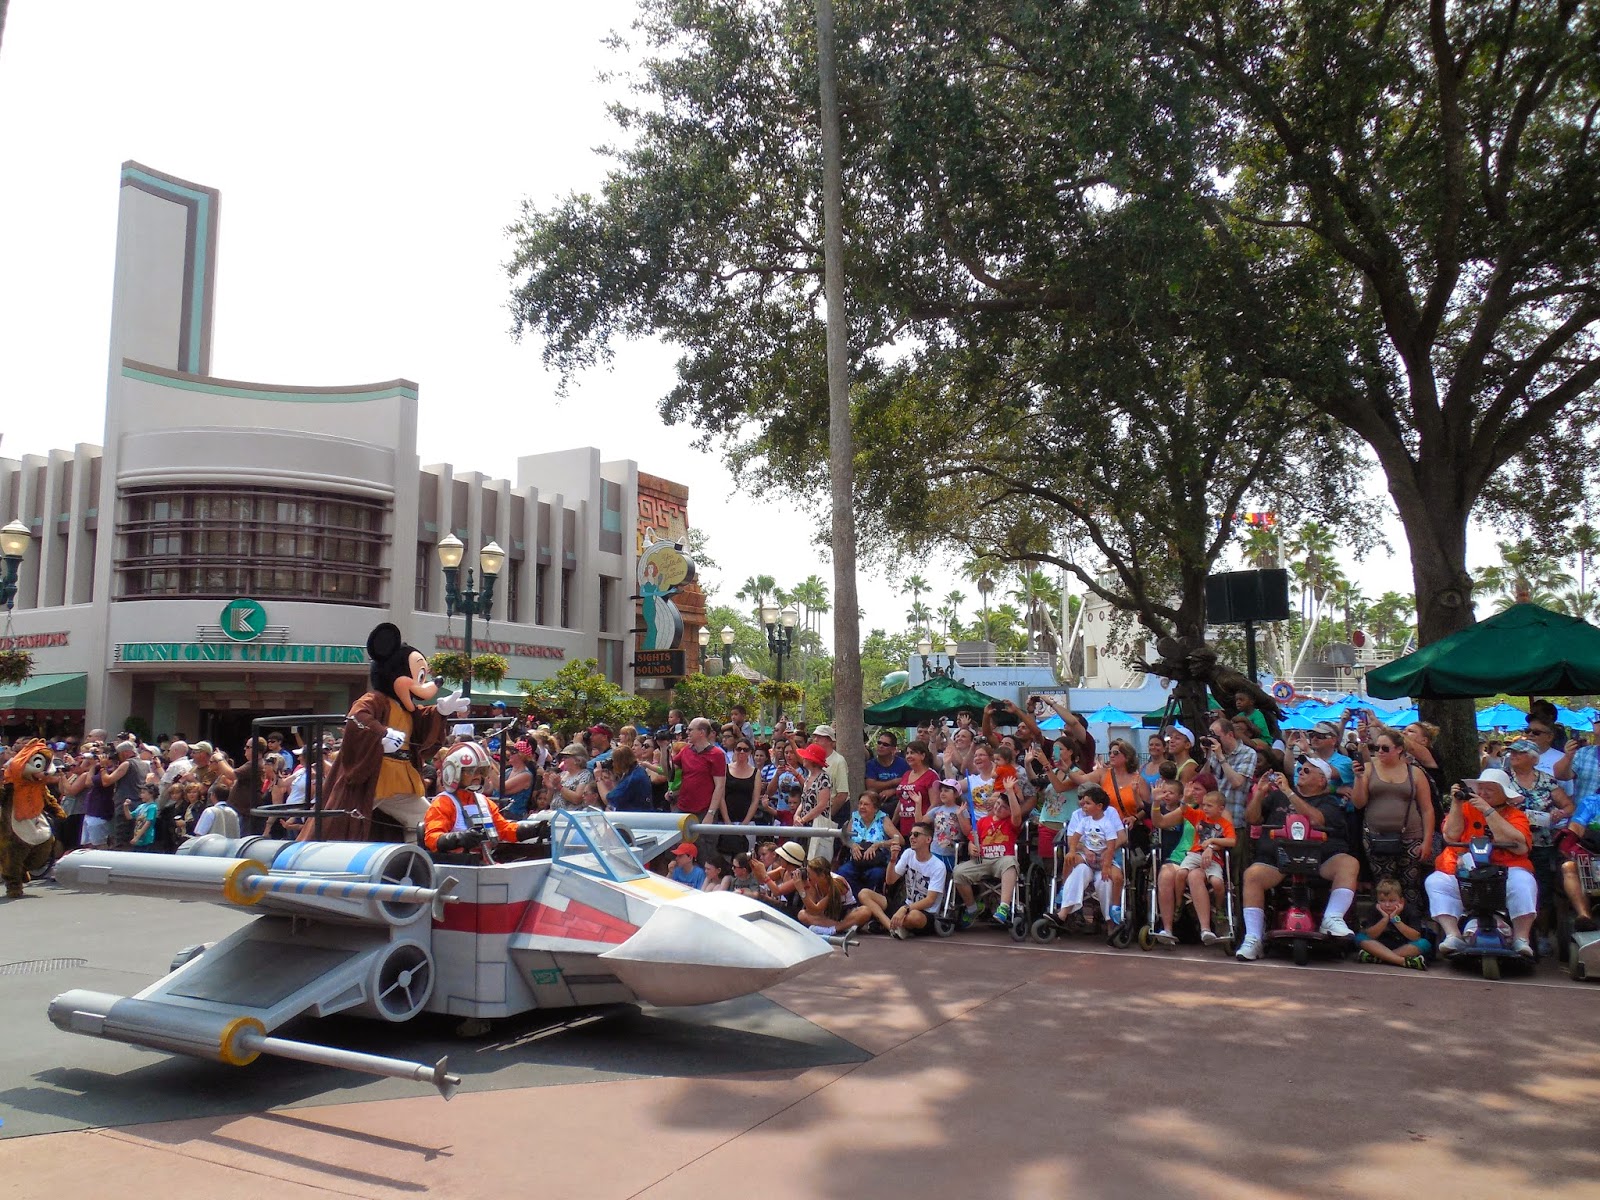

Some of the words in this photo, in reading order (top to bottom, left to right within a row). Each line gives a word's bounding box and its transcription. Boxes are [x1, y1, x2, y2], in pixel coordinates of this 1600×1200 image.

[230, 608, 255, 632] K
[122, 643, 232, 661] KEYSTONE
[241, 645, 364, 663] CLOTHIERS
[436, 635, 511, 655] HOLLWOOD
[514, 644, 565, 659] FASHIONS
[637, 652, 671, 662] SIGHTS
[635, 665, 672, 675] SOUNDS
